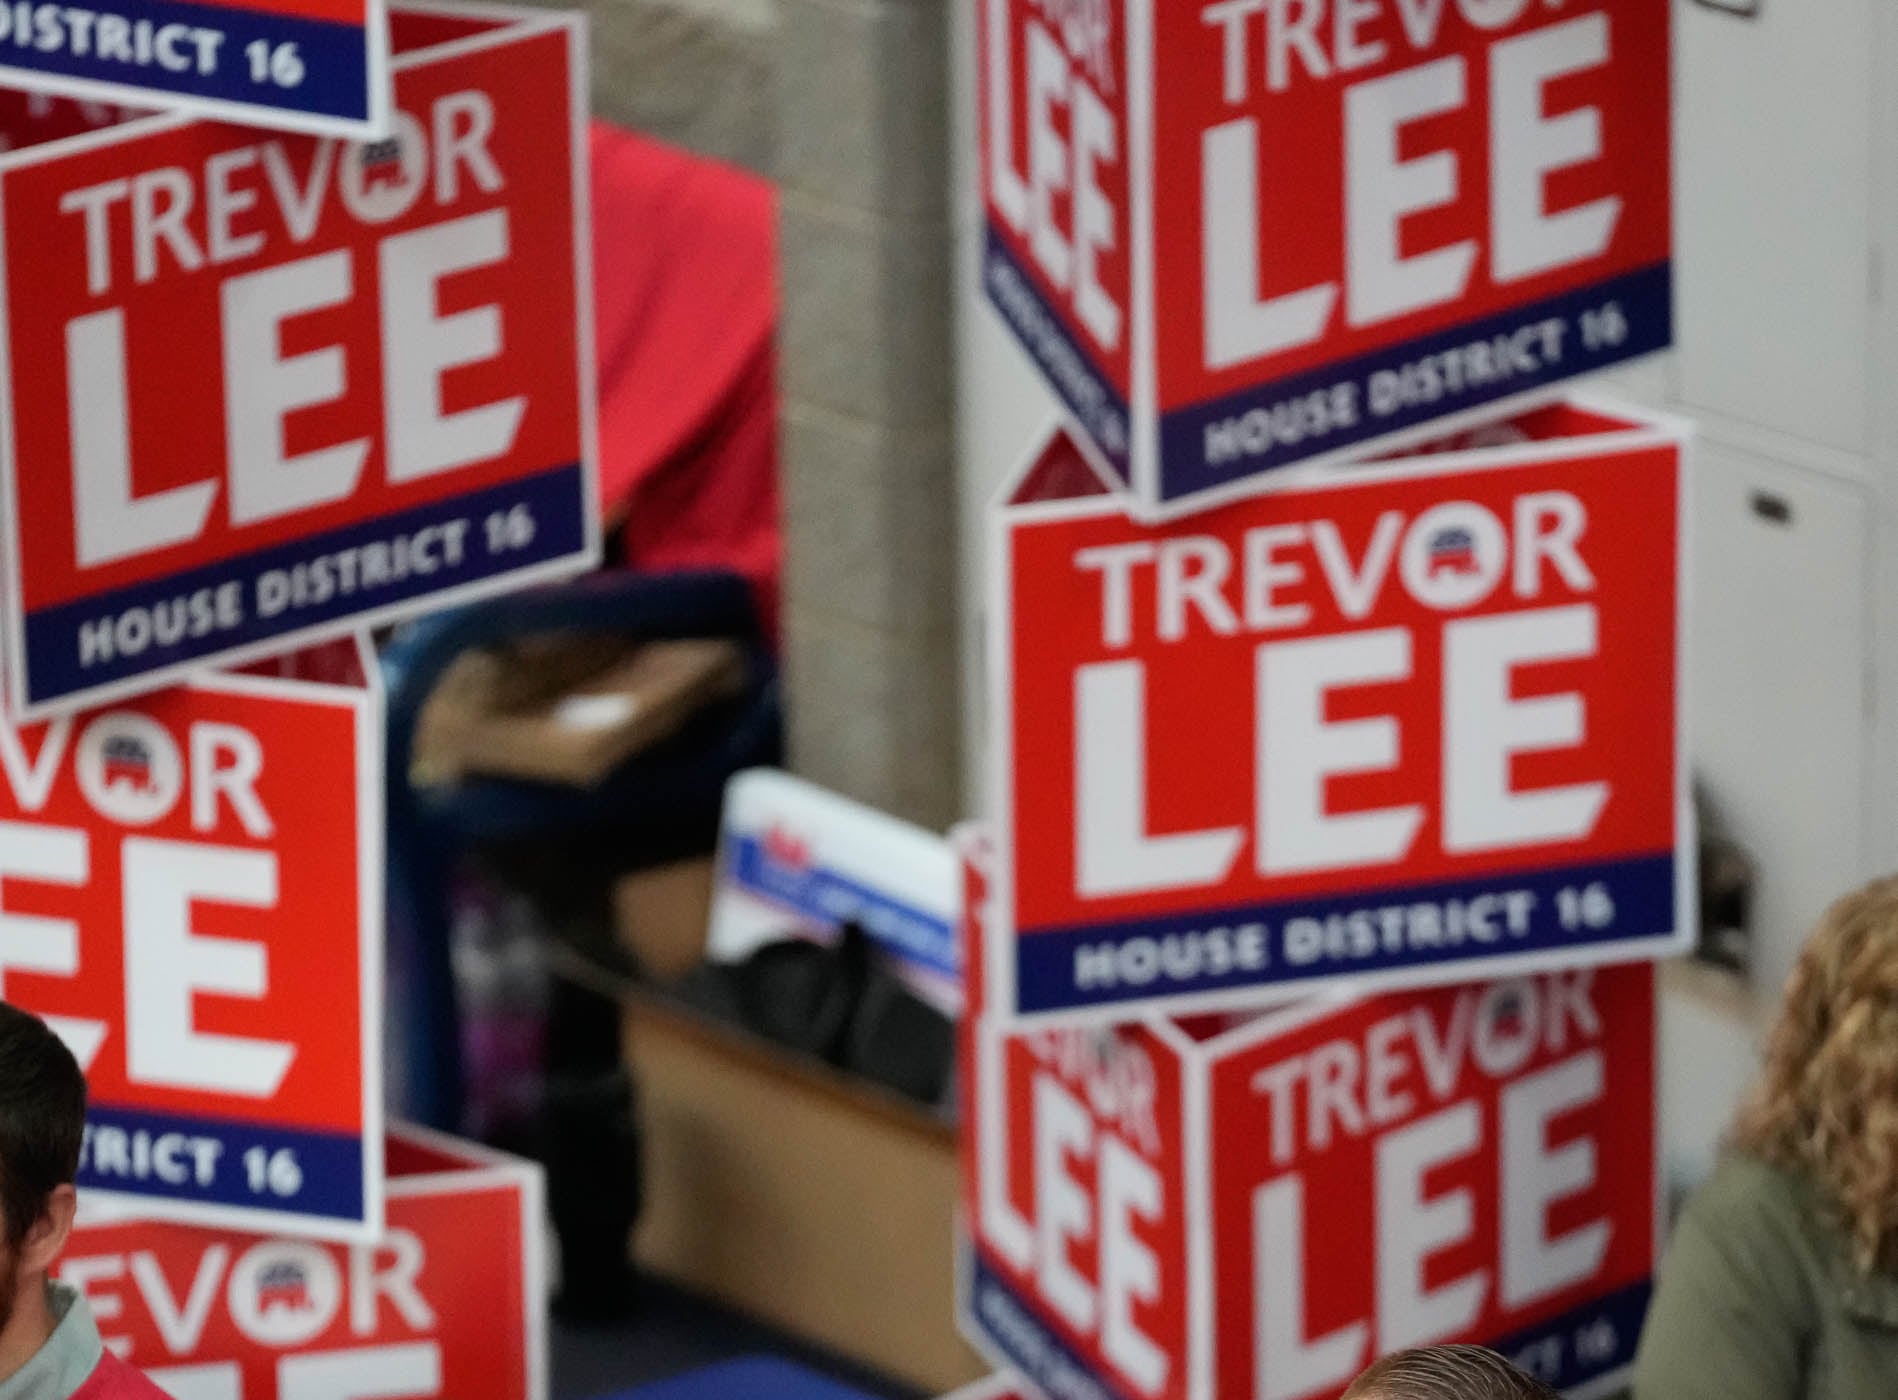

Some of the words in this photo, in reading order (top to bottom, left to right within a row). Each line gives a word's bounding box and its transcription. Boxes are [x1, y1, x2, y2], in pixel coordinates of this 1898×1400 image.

[246, 39, 304, 88] 16
[1202, 0, 1565, 104] TRE
[60, 89, 502, 296] TREVOR
[1202, 10, 1621, 369] LEE
[65, 207, 527, 570] LEE
[1204, 384, 1360, 466] HOUSE
[1367, 318, 1570, 416] DISTRICT
[1579, 303, 1629, 351] 16
[79, 582, 243, 668] HOUSE
[256, 520, 469, 617] DISTRICT
[484, 504, 535, 552] 16
[1074, 490, 1596, 648] TREVOR
[1074, 602, 1611, 900] LEE
[1074, 922, 1268, 991] HOUSE
[1284, 890, 1536, 965] DISTRICT
[1553, 884, 1614, 935] 16
[1250, 966, 1603, 1165] TREVOR
[244, 1146, 304, 1197] 16
